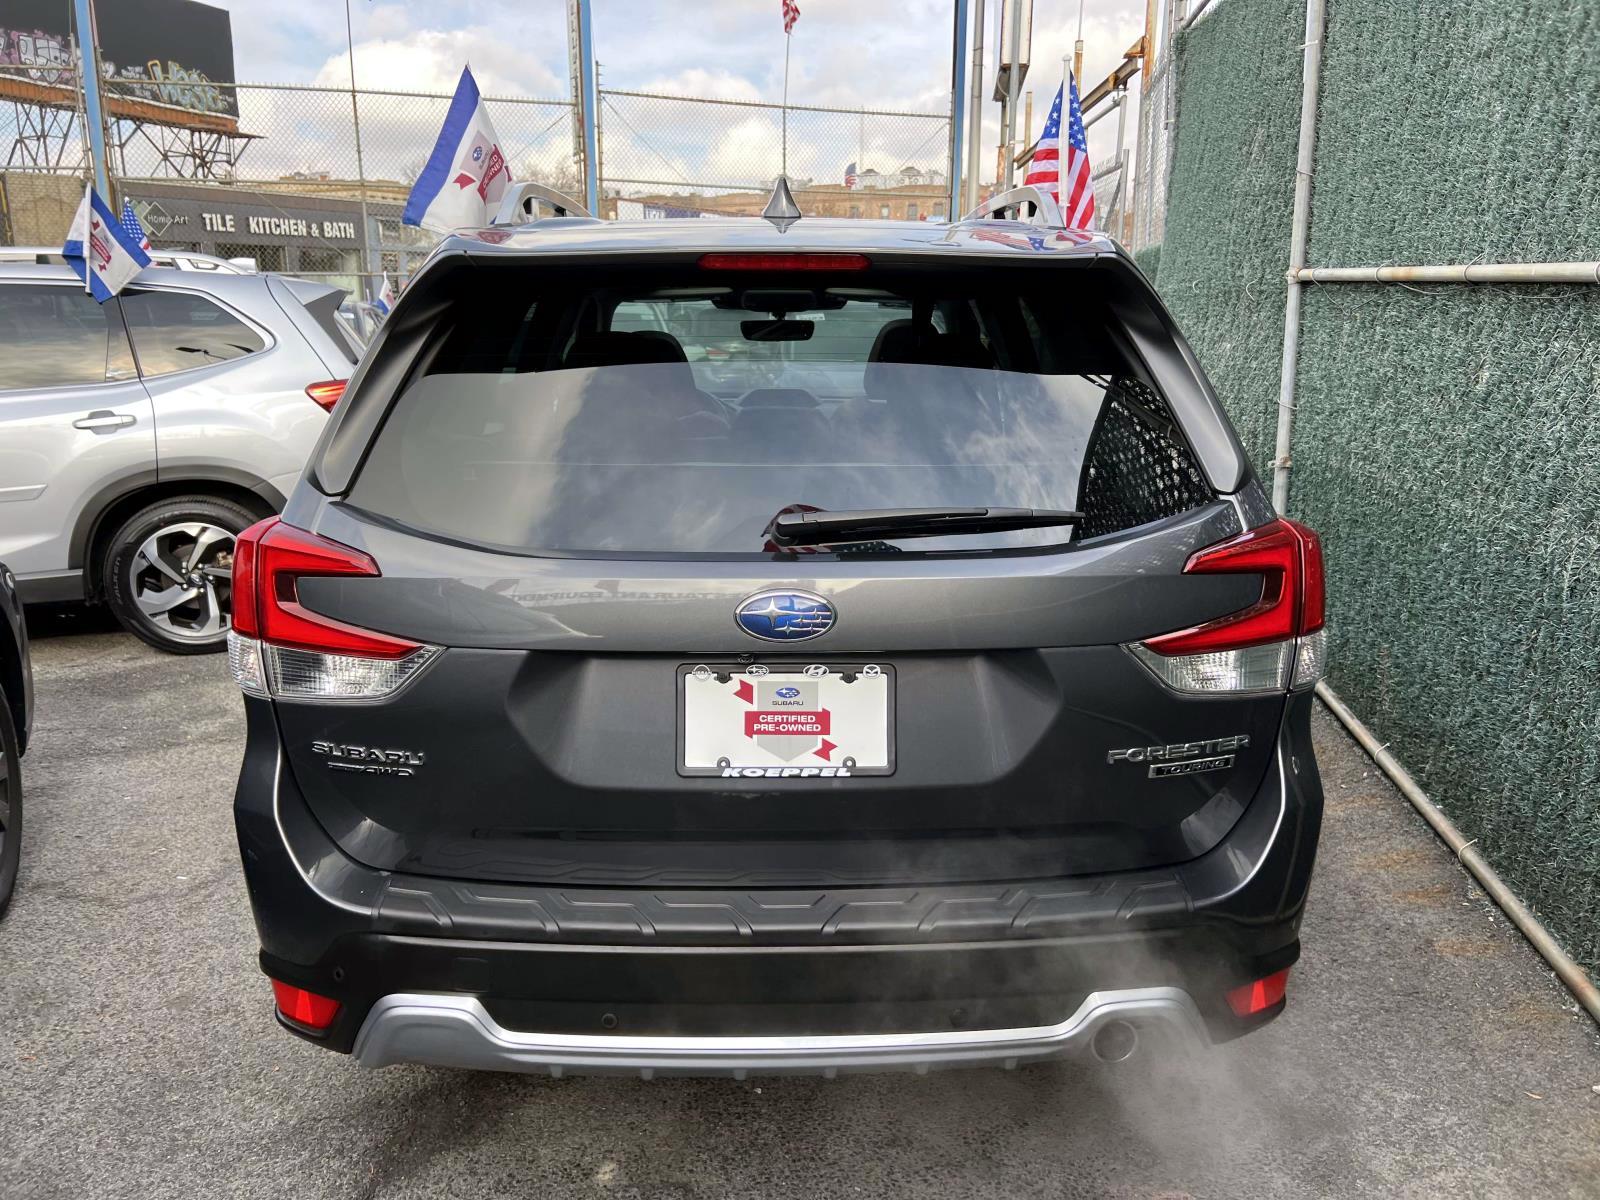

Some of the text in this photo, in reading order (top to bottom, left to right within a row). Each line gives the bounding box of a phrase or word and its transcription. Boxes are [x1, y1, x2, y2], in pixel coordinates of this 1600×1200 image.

[173, 215, 189, 224] Art
[202, 213, 355, 239] TILE KITCHEN & BATH
[759, 715, 816, 723] CERTIFIED
[753, 723, 822, 732] PRE-OWNED
[311, 741, 424, 765] SUBARU
[1107, 734, 1250, 764] FORESTER
[721, 767, 851, 777] KOEPPEL
[1161, 759, 1226, 775] TOURING
